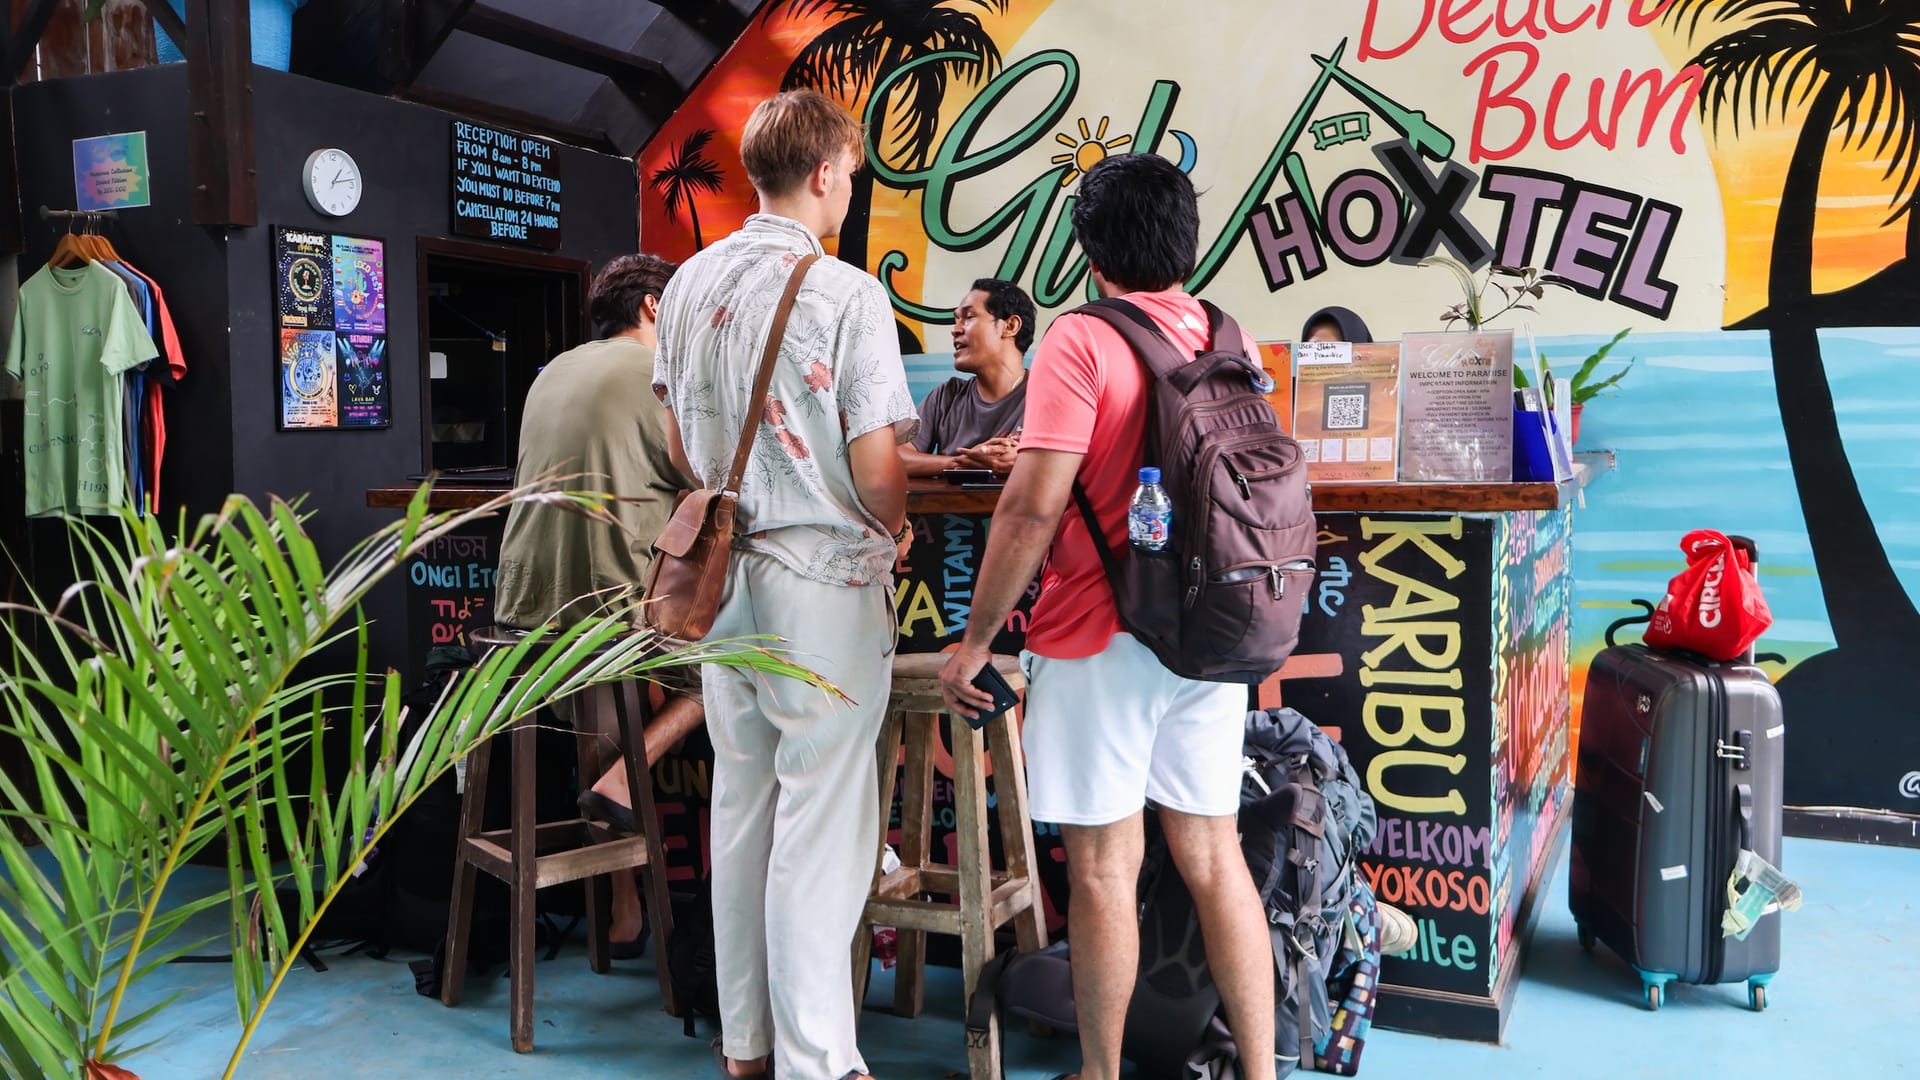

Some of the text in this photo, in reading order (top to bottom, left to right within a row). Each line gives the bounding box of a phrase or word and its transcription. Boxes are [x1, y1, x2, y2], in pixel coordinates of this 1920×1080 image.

[1356, 0, 1676, 63] Beac
[1462, 41, 1705, 164] Bum
[456, 121, 551, 160] RECEPTION OPEN
[456, 140, 487, 158] FROM
[349, 181, 354, 189] 3
[457, 157, 561, 193] IF YOU WANT TO EXTEND
[457, 176, 478, 195] YOU
[479, 182, 501, 199] MUST
[503, 186, 513, 202] DO
[515, 189, 545, 207] BEFORE
[457, 199, 559, 229] CANCELLATION 24 HOURS
[491, 221, 528, 239] BEFORE
[1246, 137, 1683, 321] HOXTEL
[285, 232, 324, 246] KARAOKE
[1410, 371, 1451, 379] WELCOME
[411, 561, 461, 588] ONGI
[943, 513, 975, 635] WITAMY
[1699, 554, 1726, 628] CIRCL
[1498, 511, 1510, 703] ALOHA
[1358, 516, 1467, 816] KARIBU
[1361, 861, 1490, 916] YOKOSO
